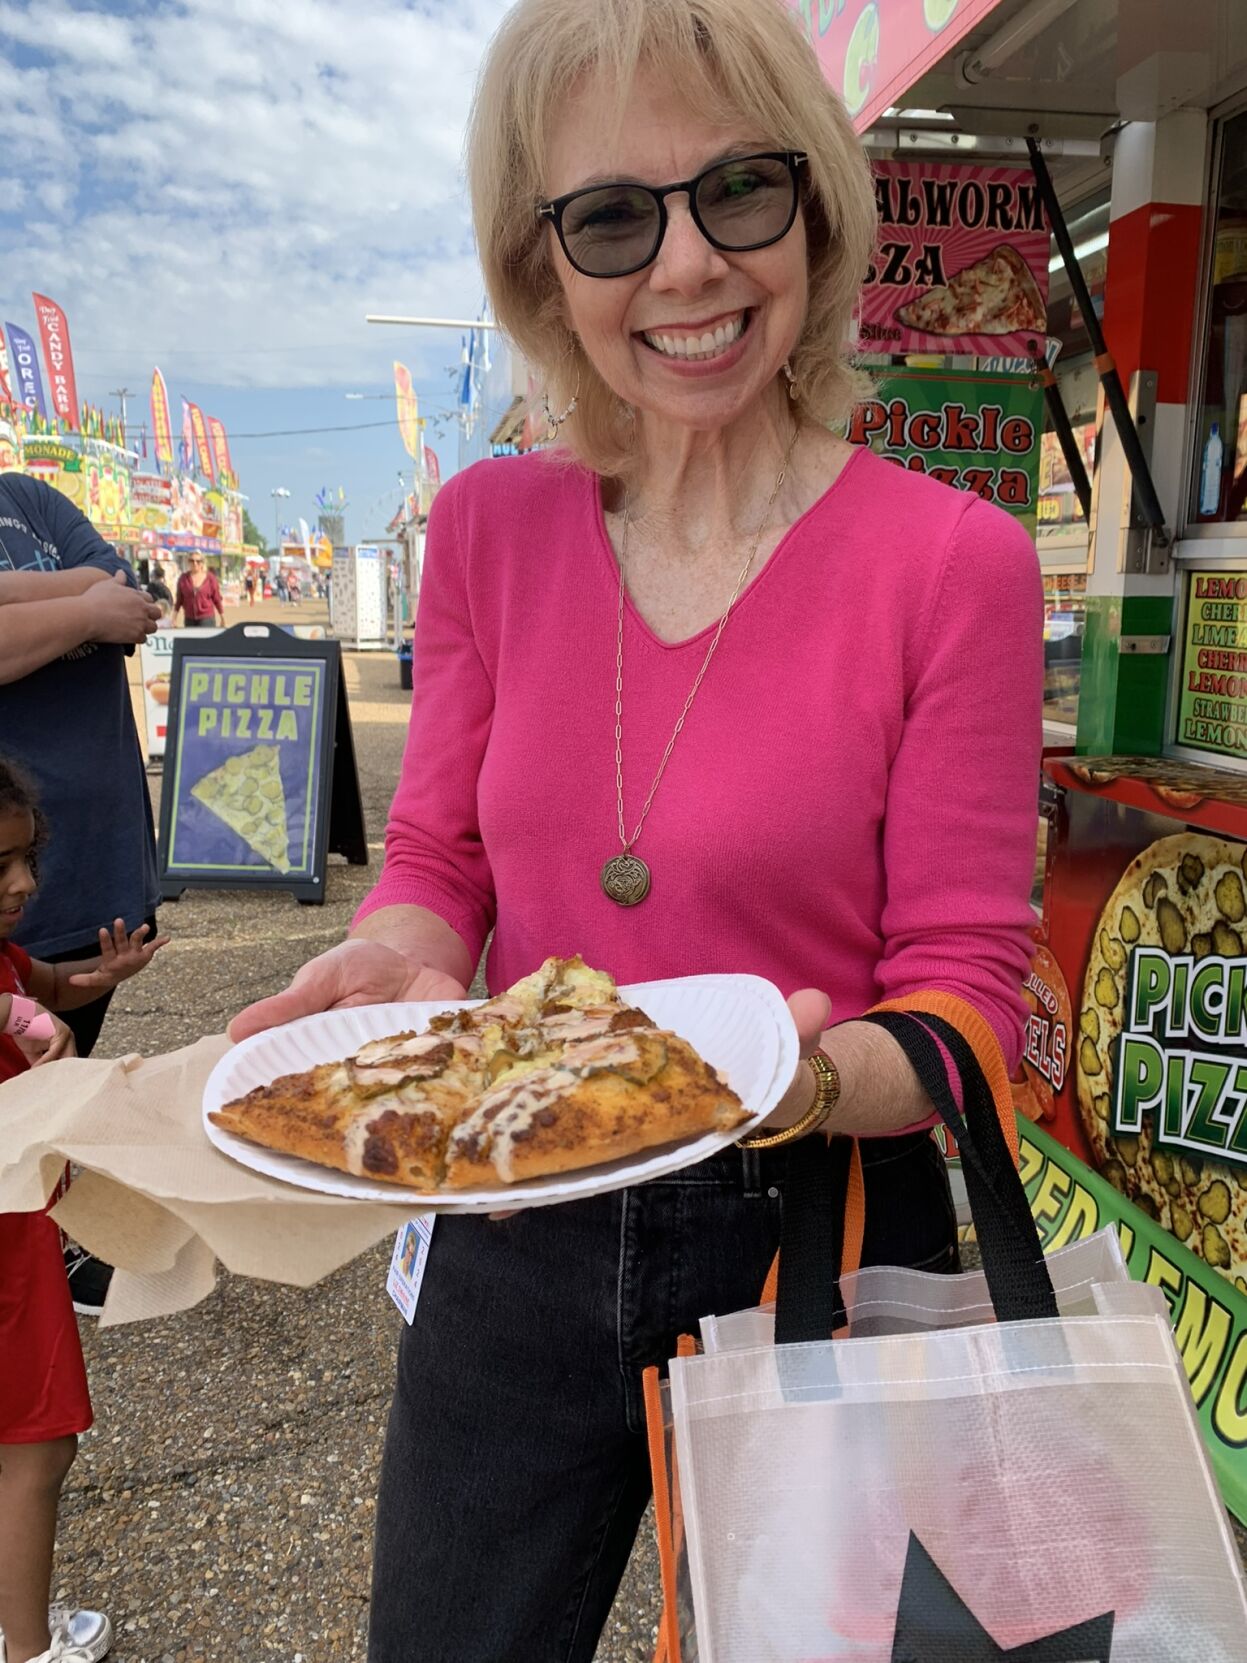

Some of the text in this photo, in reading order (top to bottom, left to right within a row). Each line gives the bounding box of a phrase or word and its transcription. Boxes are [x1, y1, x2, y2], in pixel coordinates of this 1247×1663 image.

[873, 177, 1045, 231] ALWORM
[47, 323, 69, 413] CANDY BARS
[848, 400, 1034, 453] Pickle
[881, 454, 1030, 506] zza
[198, 707, 298, 741] PIZZA
